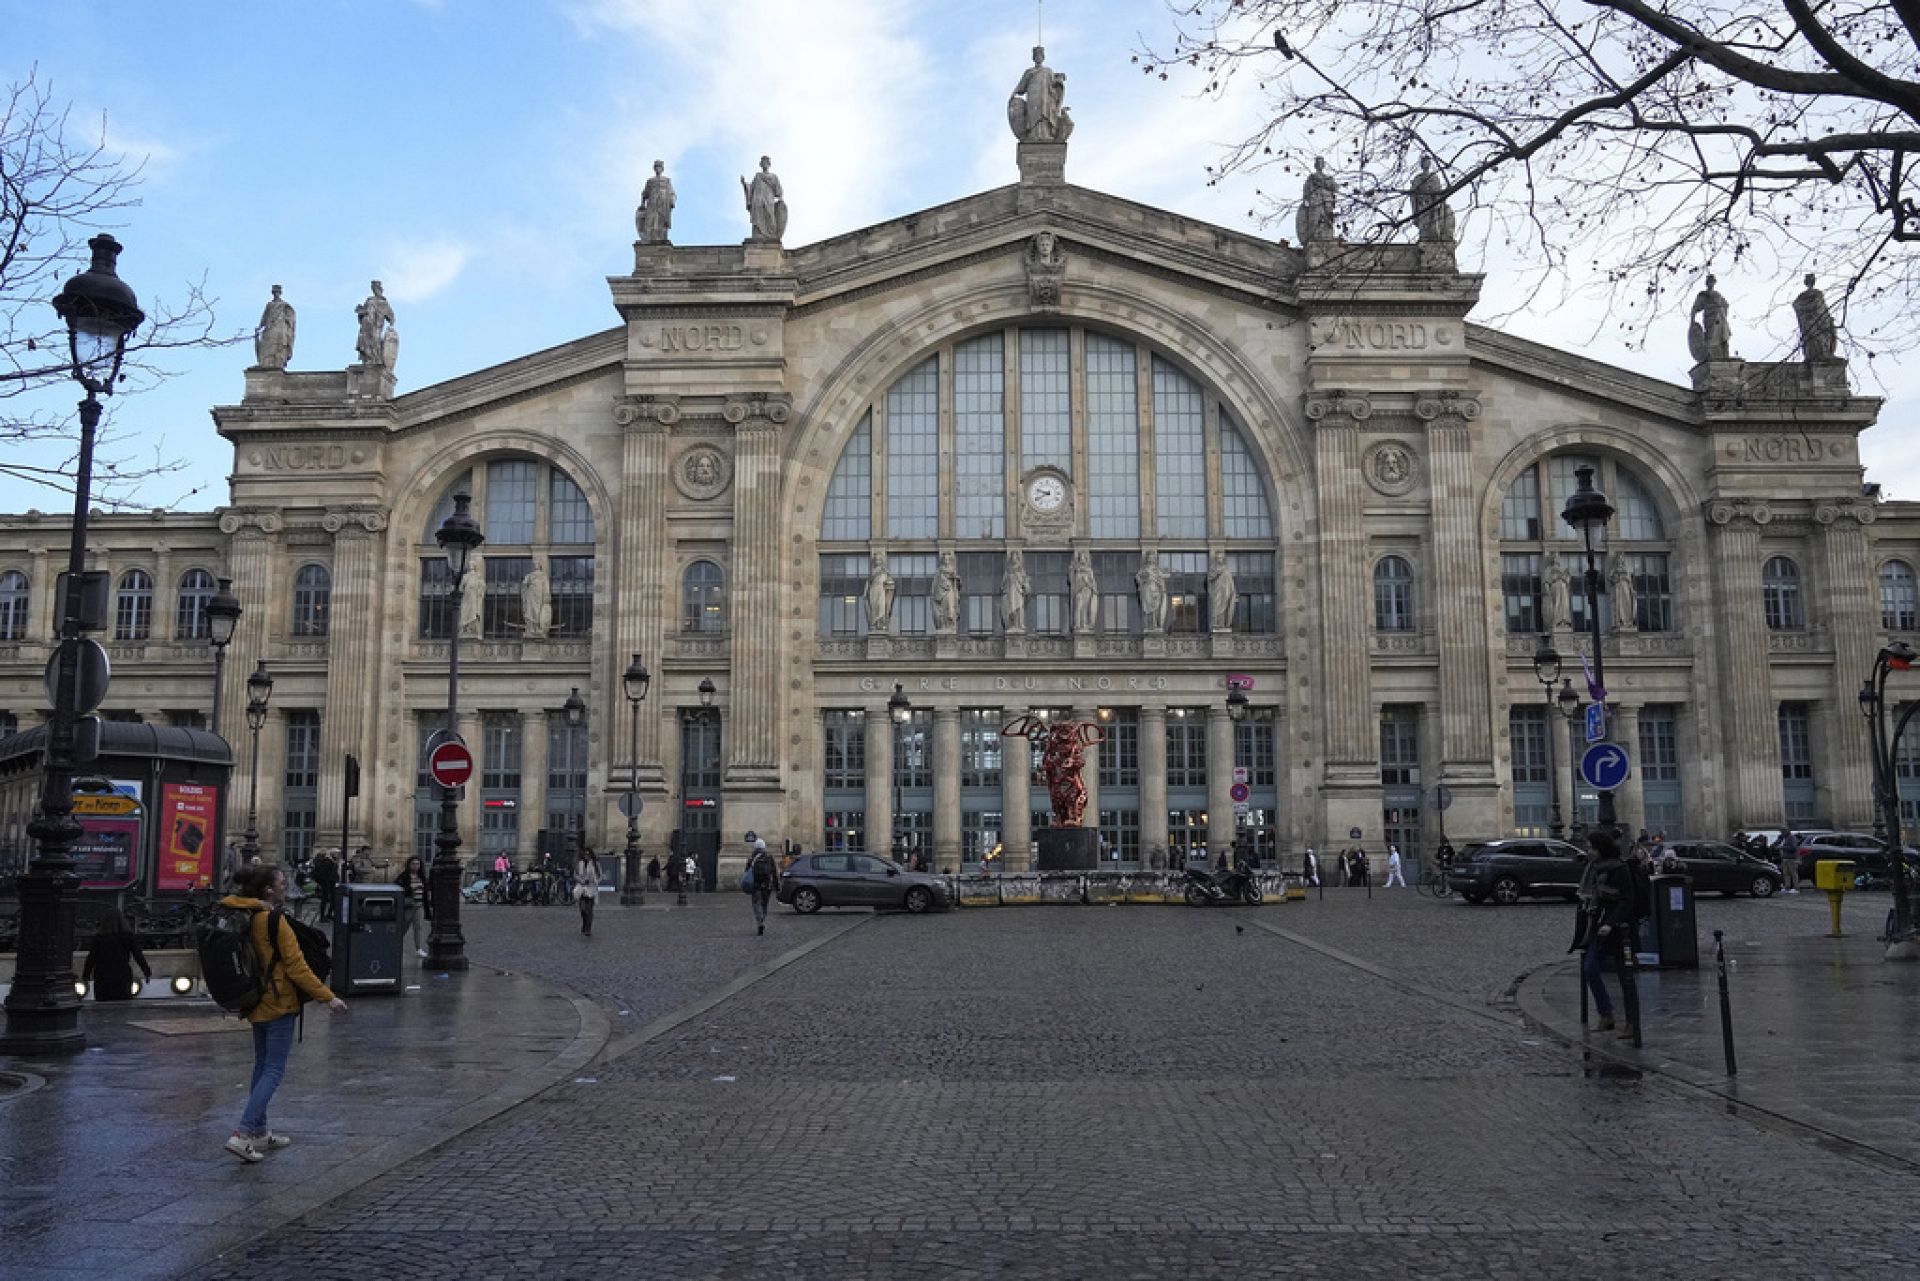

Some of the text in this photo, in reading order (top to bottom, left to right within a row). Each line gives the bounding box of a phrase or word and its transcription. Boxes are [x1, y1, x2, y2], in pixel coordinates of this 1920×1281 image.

[661, 325, 743, 351] NORD
[1344, 323, 1427, 349] NORD
[264, 445, 346, 470] NORD
[1743, 438, 1823, 462] NORD
[861, 677, 1168, 690] GARE DU NORD
